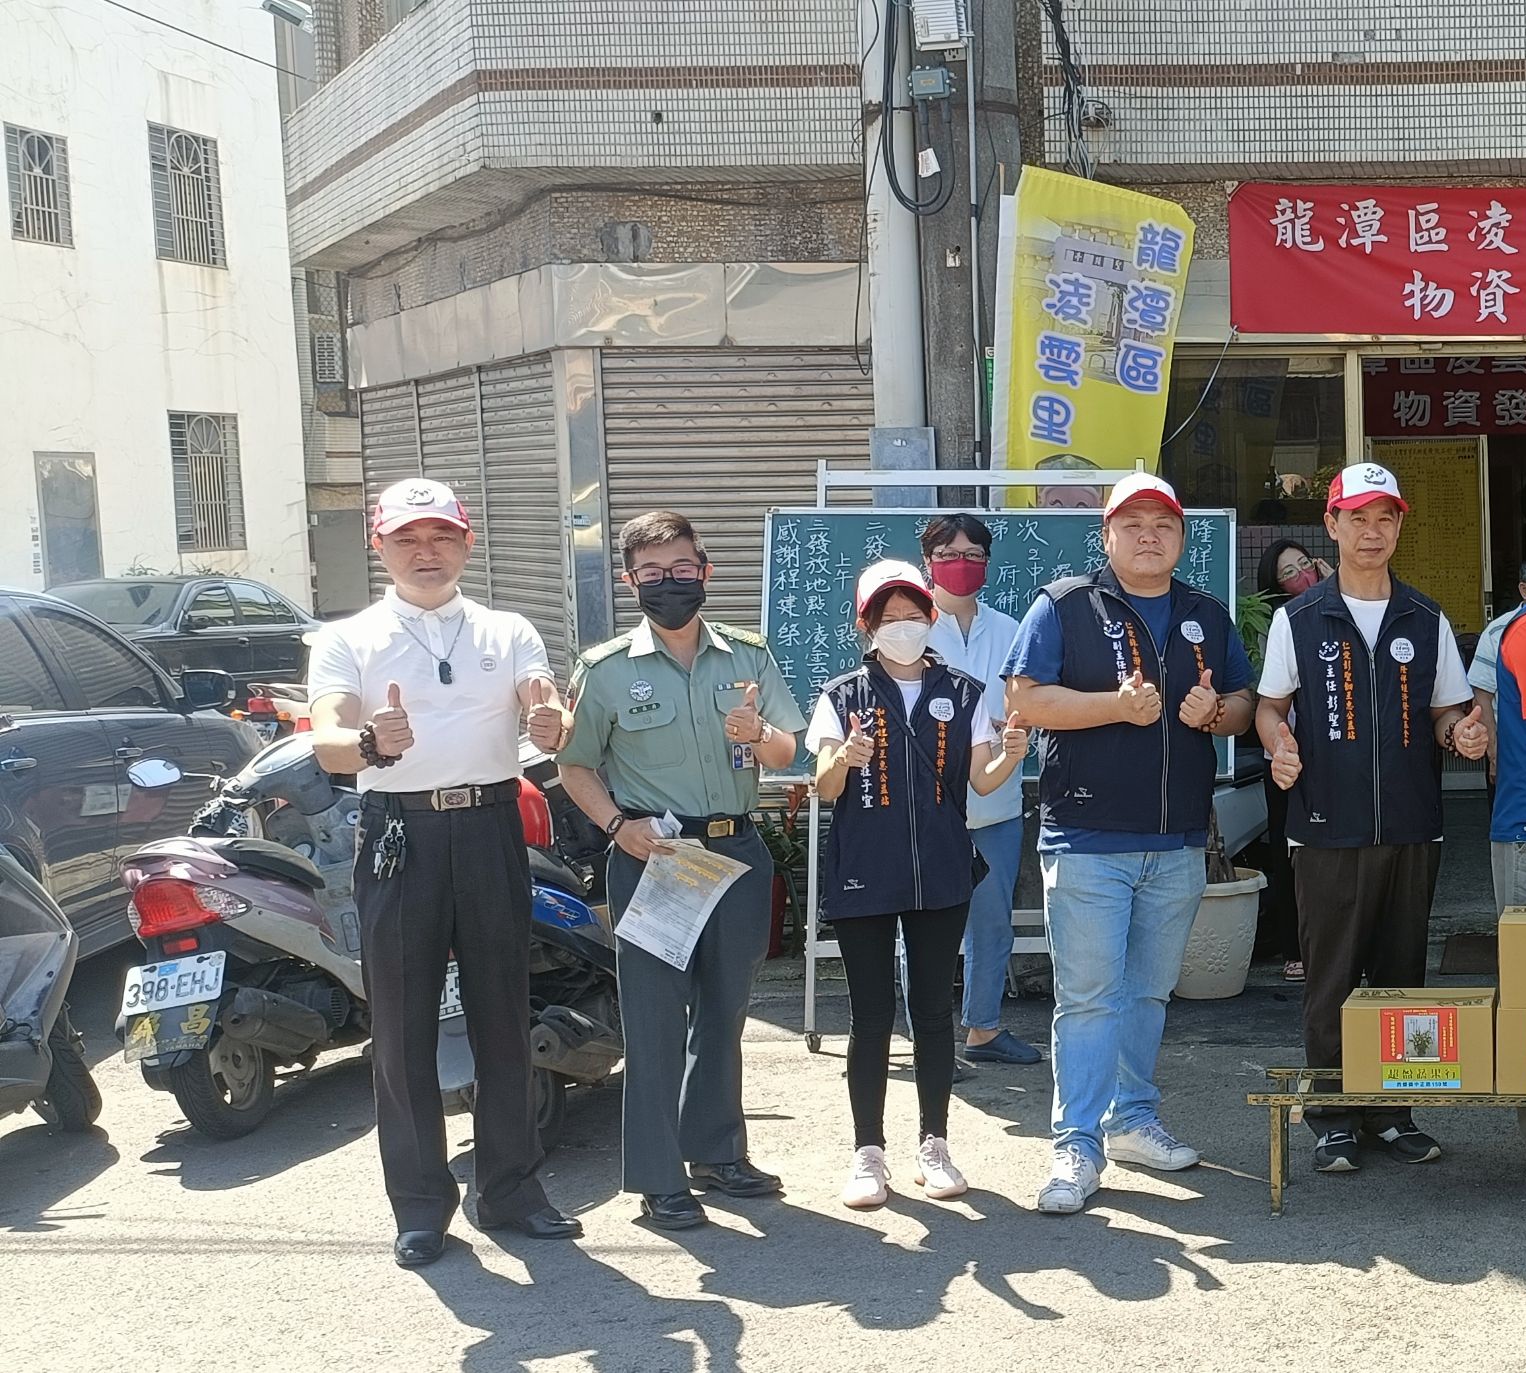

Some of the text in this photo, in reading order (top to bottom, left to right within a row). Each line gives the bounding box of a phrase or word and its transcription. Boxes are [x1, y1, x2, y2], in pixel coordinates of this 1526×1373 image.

[1032, 275, 1094, 444] 凌雲里
[1119, 222, 1184, 392] 龍潭區
[126, 967, 220, 1008] 398-EHJ
